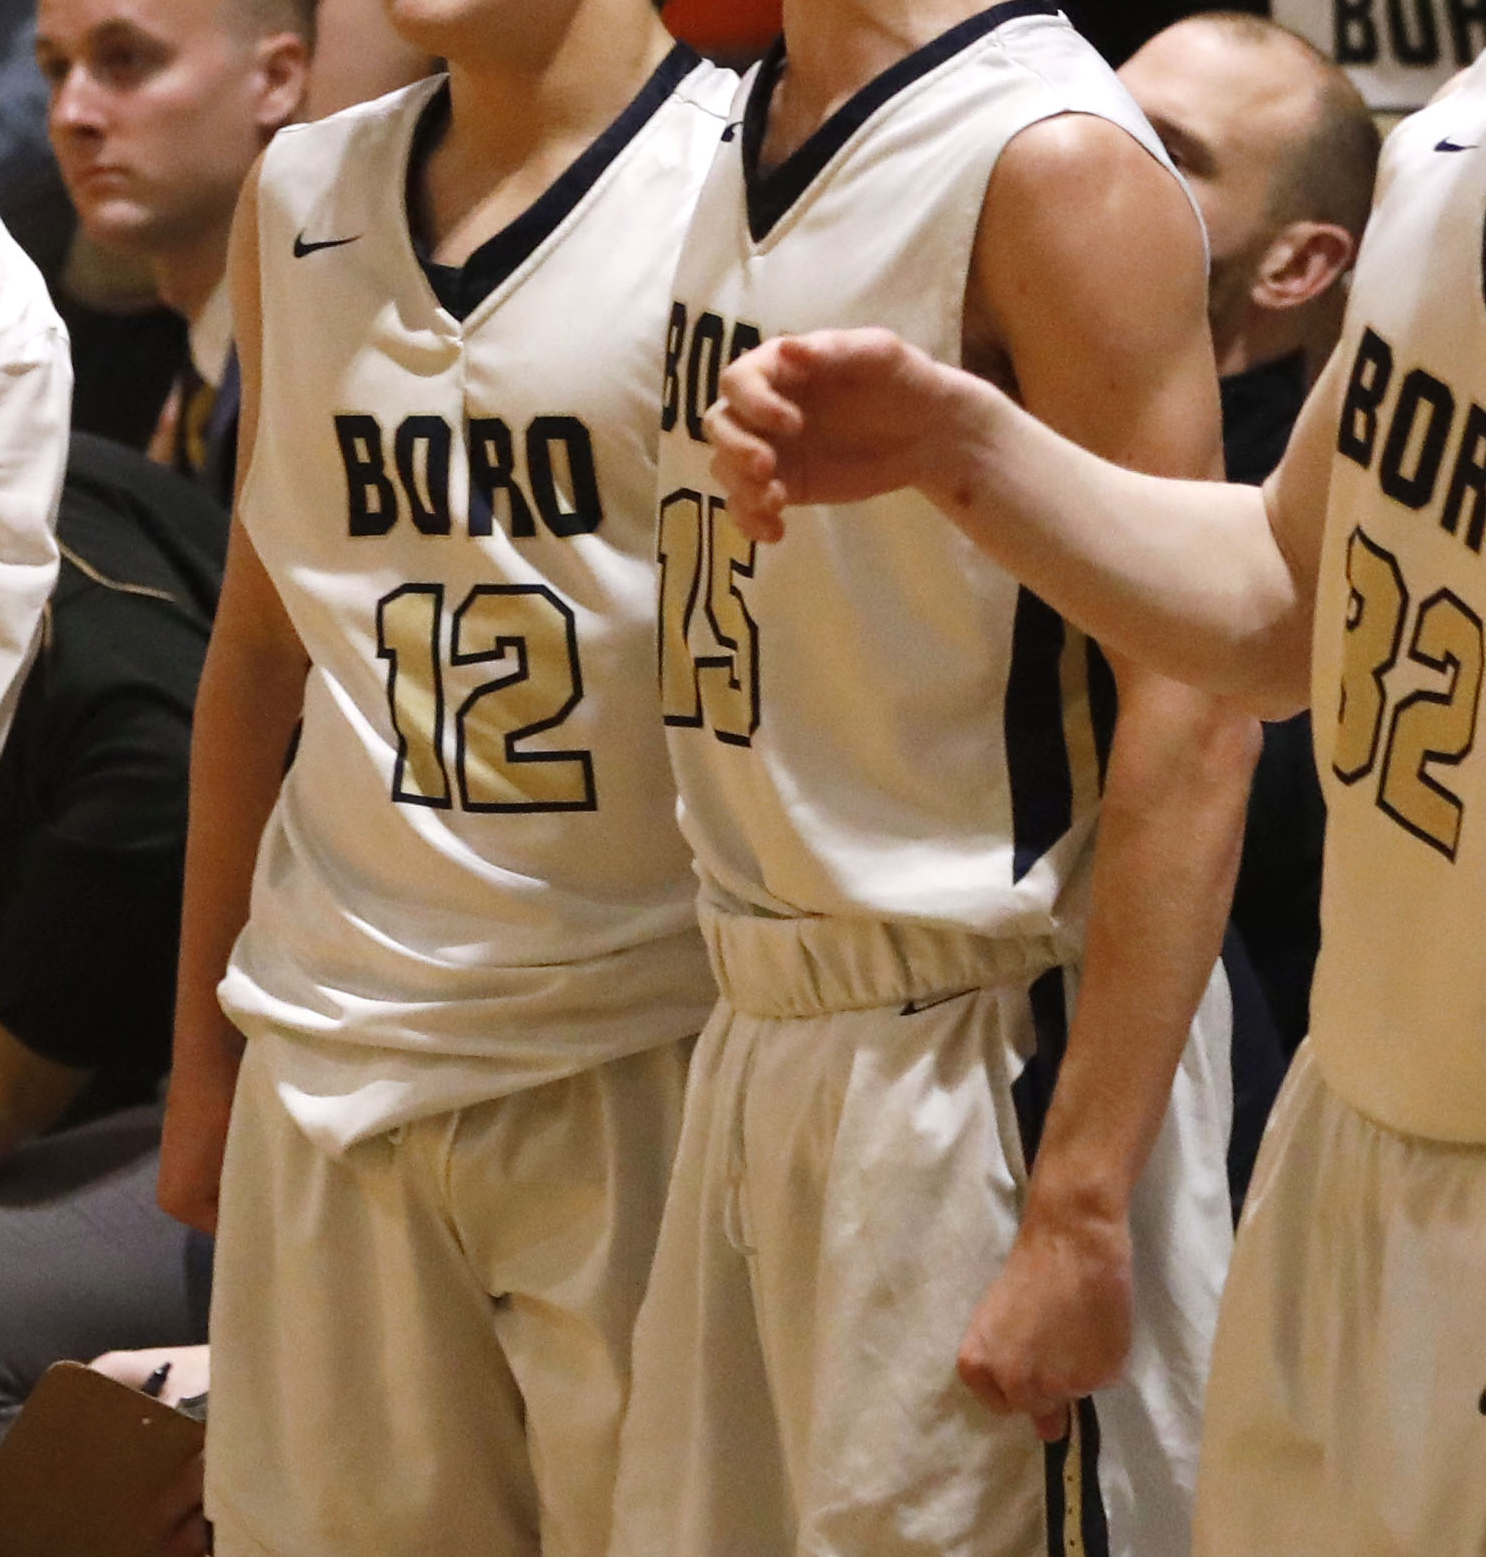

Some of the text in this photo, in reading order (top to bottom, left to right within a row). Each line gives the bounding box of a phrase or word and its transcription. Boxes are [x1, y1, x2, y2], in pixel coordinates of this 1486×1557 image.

[333, 414, 604, 538] BORO
[376, 582, 598, 813] 12
[657, 487, 761, 747] 15
[1332, 523, 1486, 865] 32
